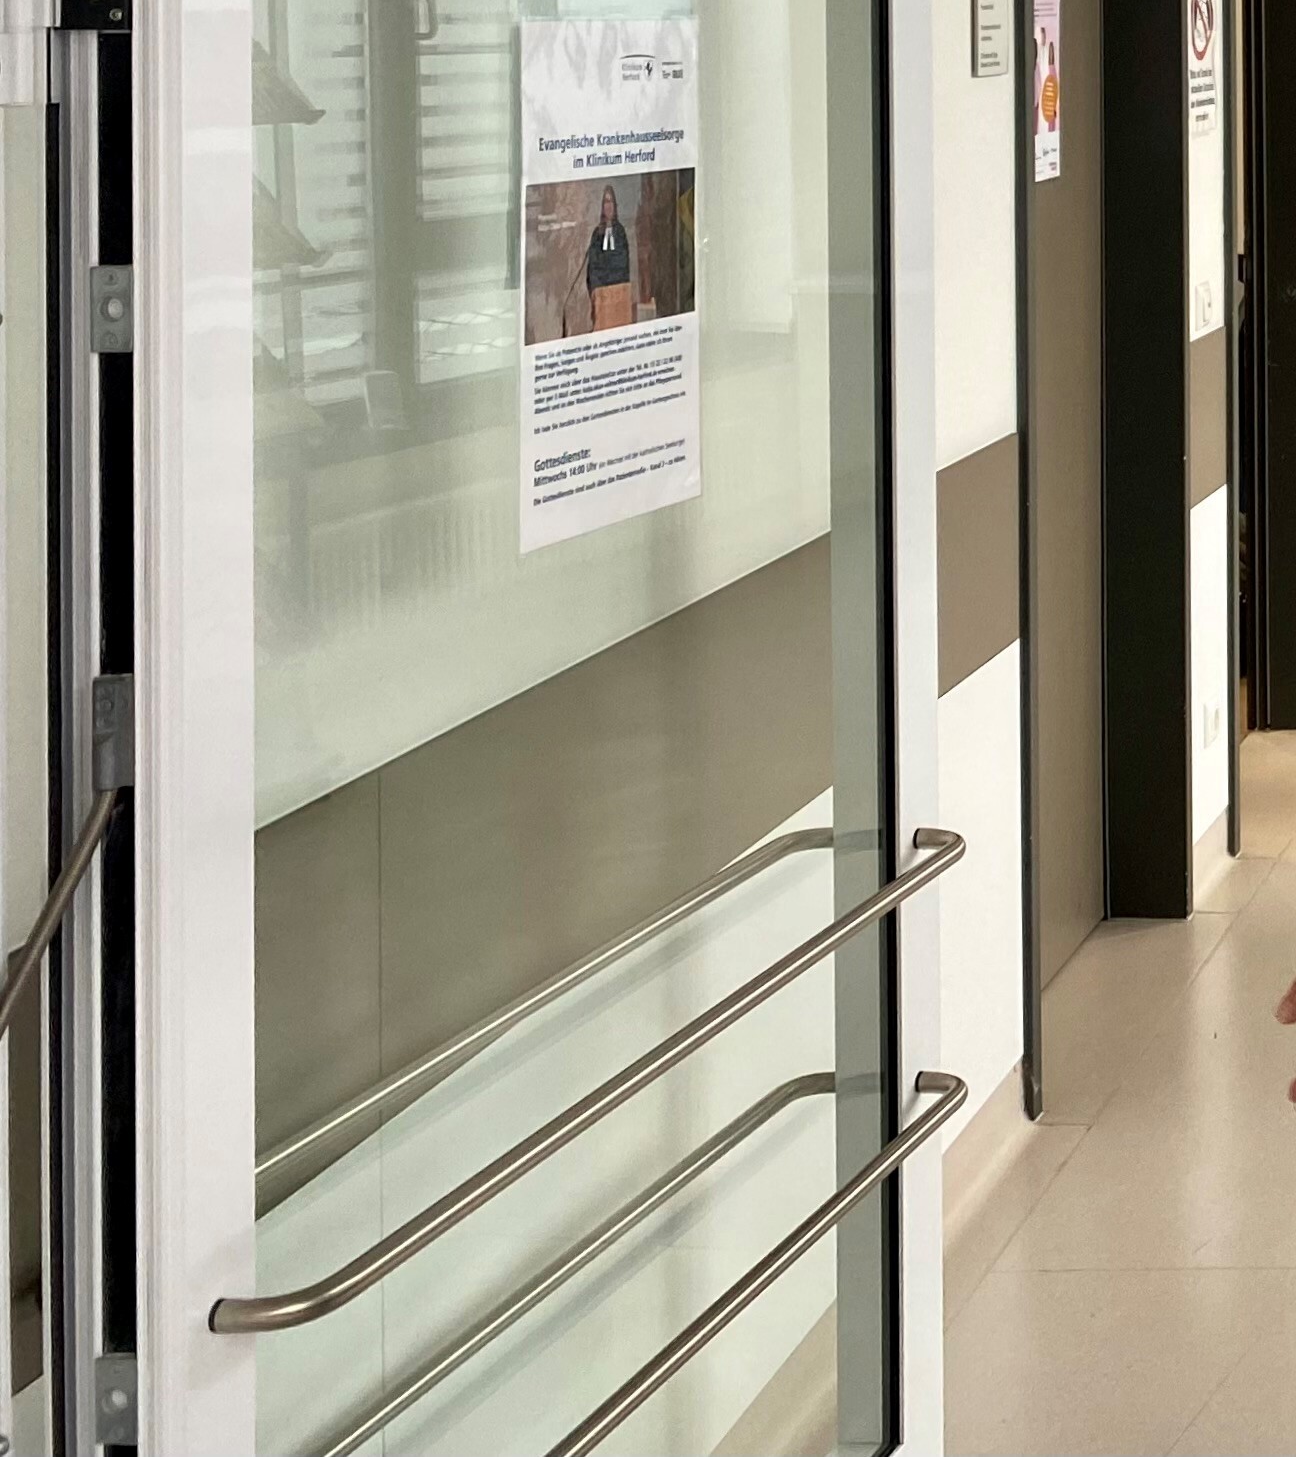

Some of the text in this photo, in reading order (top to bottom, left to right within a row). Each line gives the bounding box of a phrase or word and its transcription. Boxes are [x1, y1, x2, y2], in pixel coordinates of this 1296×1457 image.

[539, 134, 594, 153] Evangelische
[573, 148, 656, 169] im Klinikum Herford
